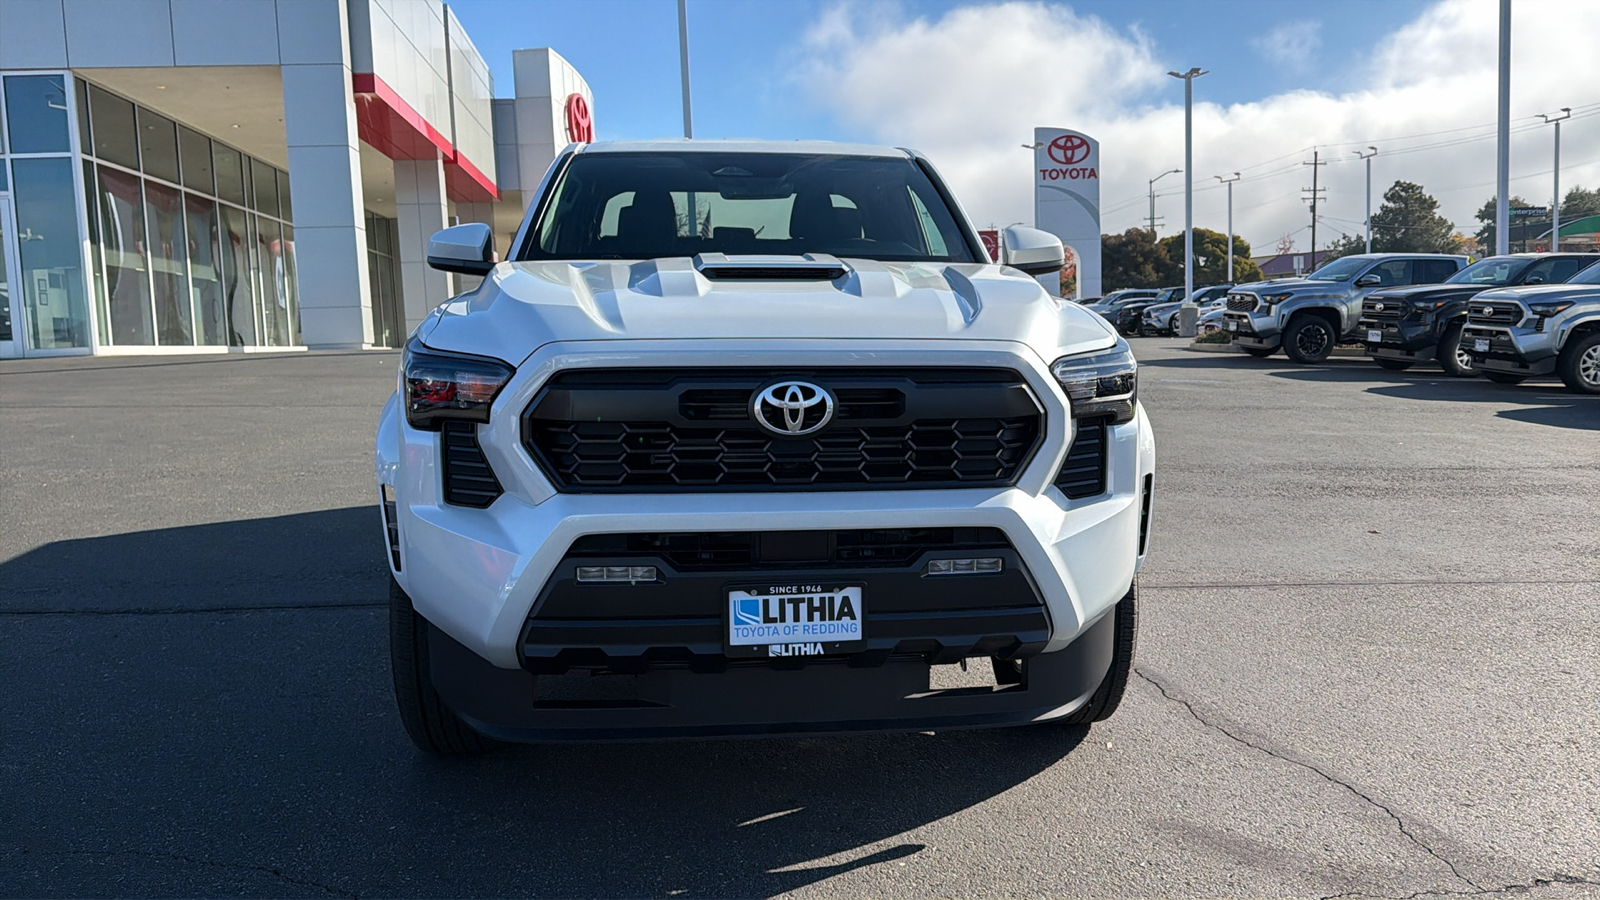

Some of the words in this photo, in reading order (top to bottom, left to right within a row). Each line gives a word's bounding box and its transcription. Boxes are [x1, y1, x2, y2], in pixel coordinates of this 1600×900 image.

[1040, 168, 1097, 180] TOYOTA
[762, 596, 857, 624] LITHIA
[734, 626, 780, 638] TOYOTA
[783, 626, 799, 636] OF
[802, 622, 858, 635] REDDING
[782, 643, 824, 656] LITHIA
